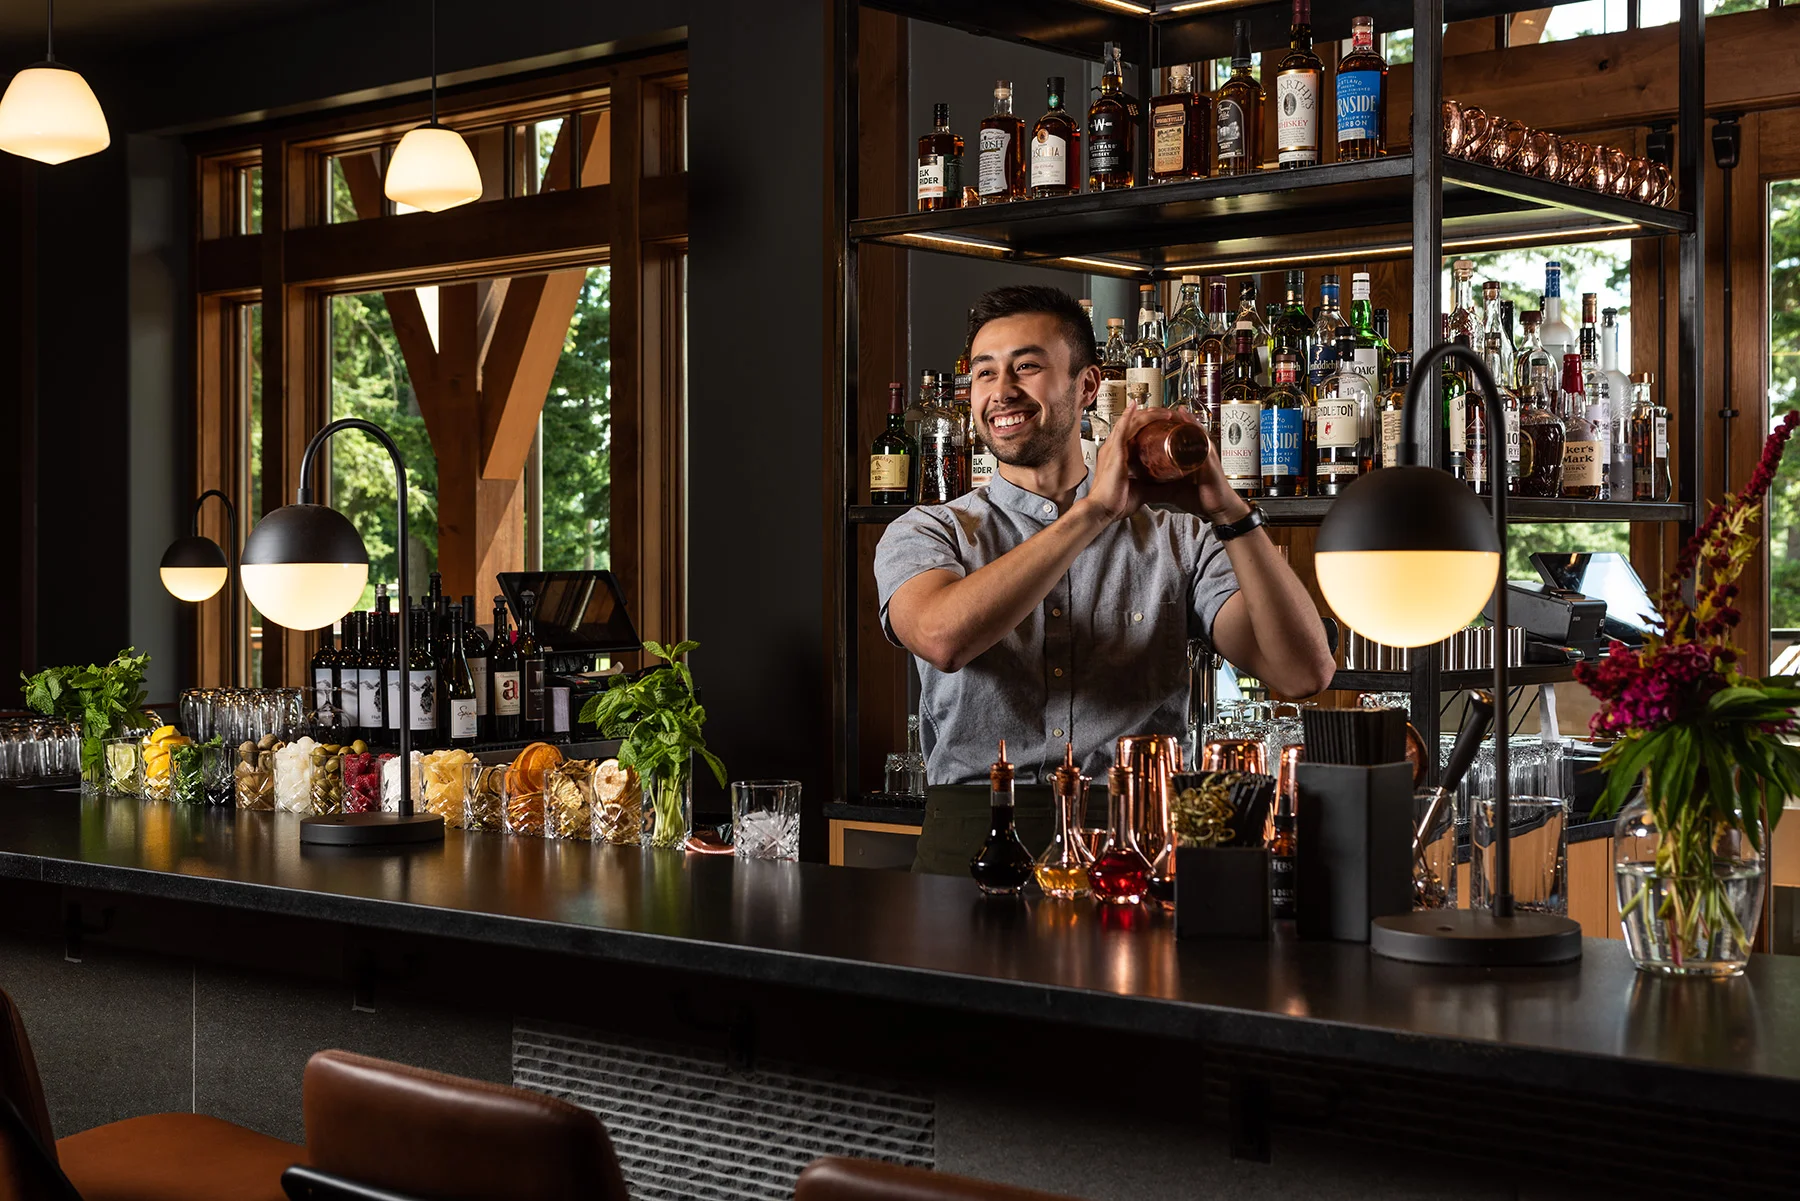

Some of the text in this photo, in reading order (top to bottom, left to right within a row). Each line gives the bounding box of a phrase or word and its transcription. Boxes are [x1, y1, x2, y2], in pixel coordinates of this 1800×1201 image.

[1094, 118, 1105, 131] W
[973, 458, 983, 466] ELK
[503, 680, 519, 700] a
